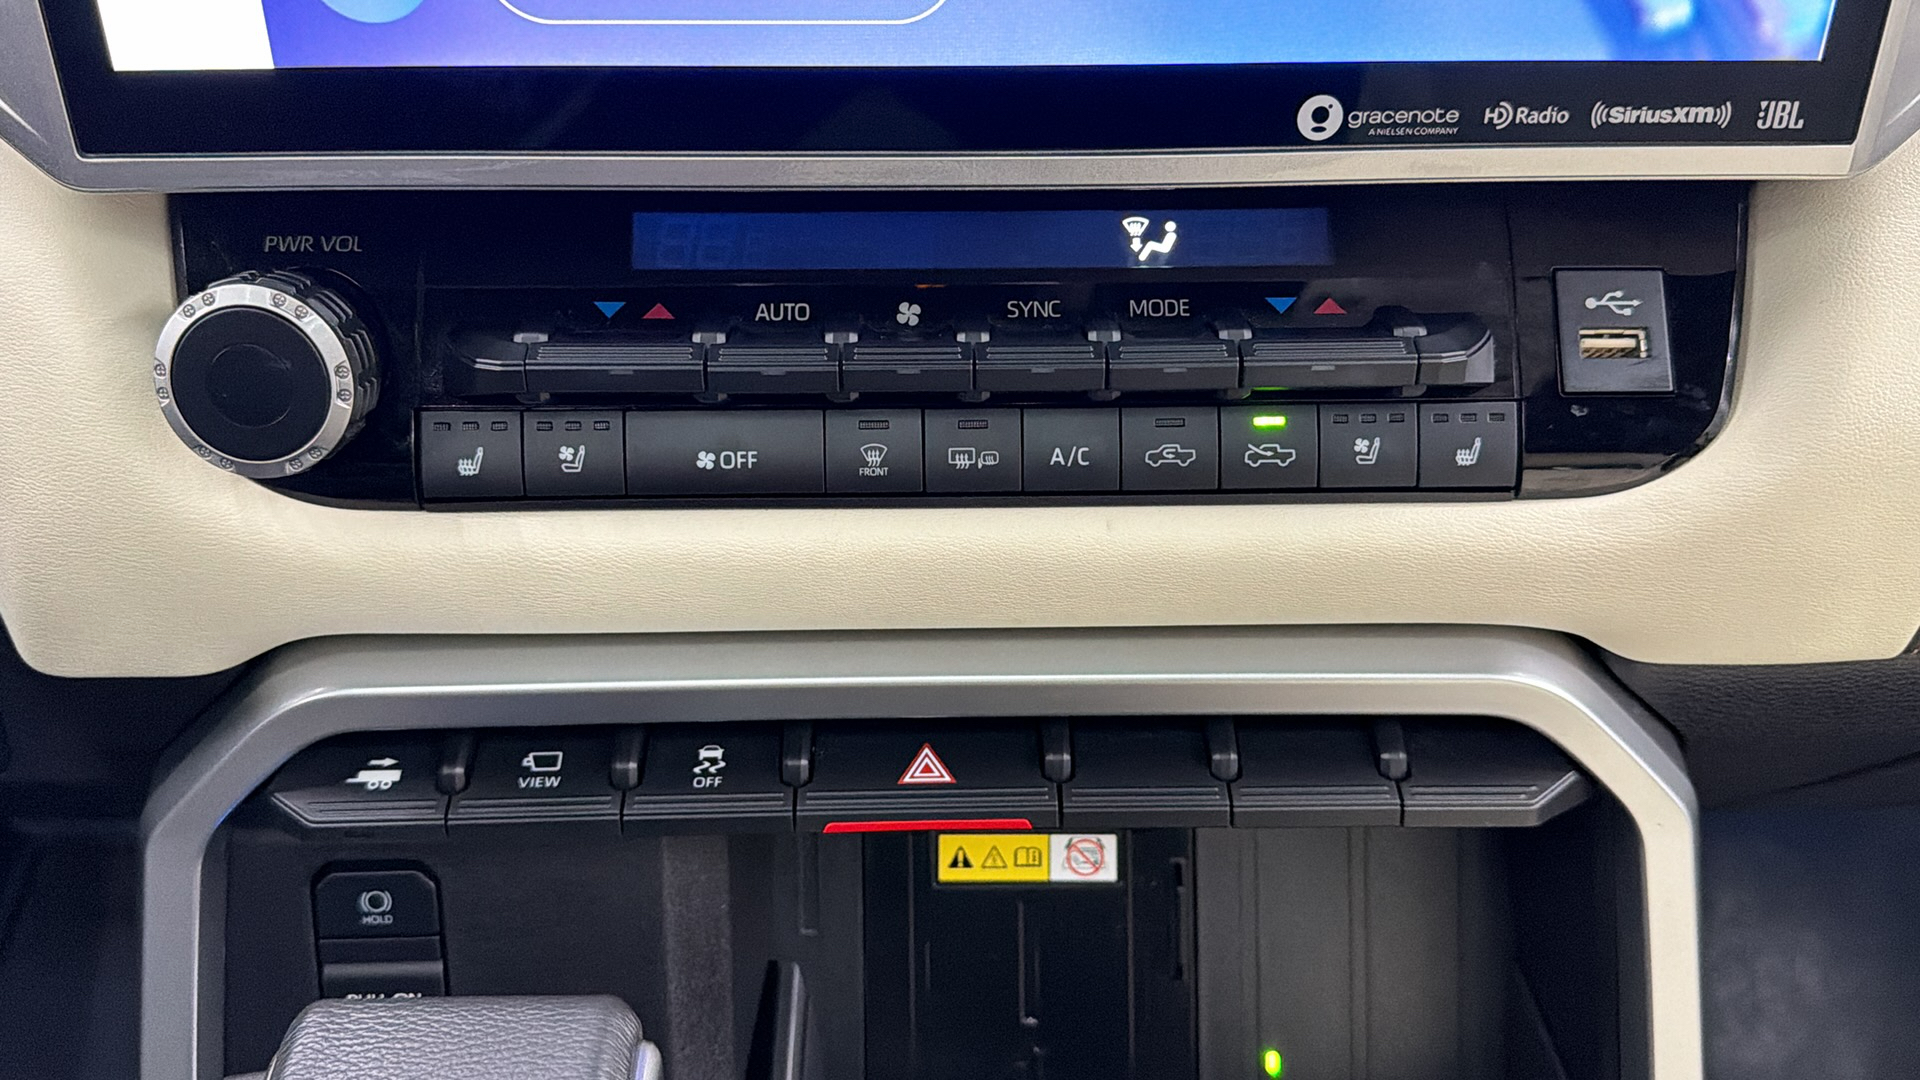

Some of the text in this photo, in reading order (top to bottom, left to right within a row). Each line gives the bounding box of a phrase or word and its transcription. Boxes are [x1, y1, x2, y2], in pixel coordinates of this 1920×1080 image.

[1347, 107, 1460, 128] gracenote
[1484, 101, 1570, 130] HD Radio
[1757, 100, 1805, 129] JBL
[1367, 126, 1460, 136] A NIELSEN COMPANY
[264, 235, 363, 253] PWR VOL
[754, 302, 811, 322] AUTO
[1006, 299, 1062, 319] SYNC
[1129, 298, 1191, 318] MODE
[719, 450, 759, 470] OFF
[1049, 446, 1090, 467] A/C
[859, 464, 889, 477] FRONT
[518, 776, 562, 789] VIEW
[692, 774, 723, 789] OFF
[361, 914, 394, 925] HOLD
